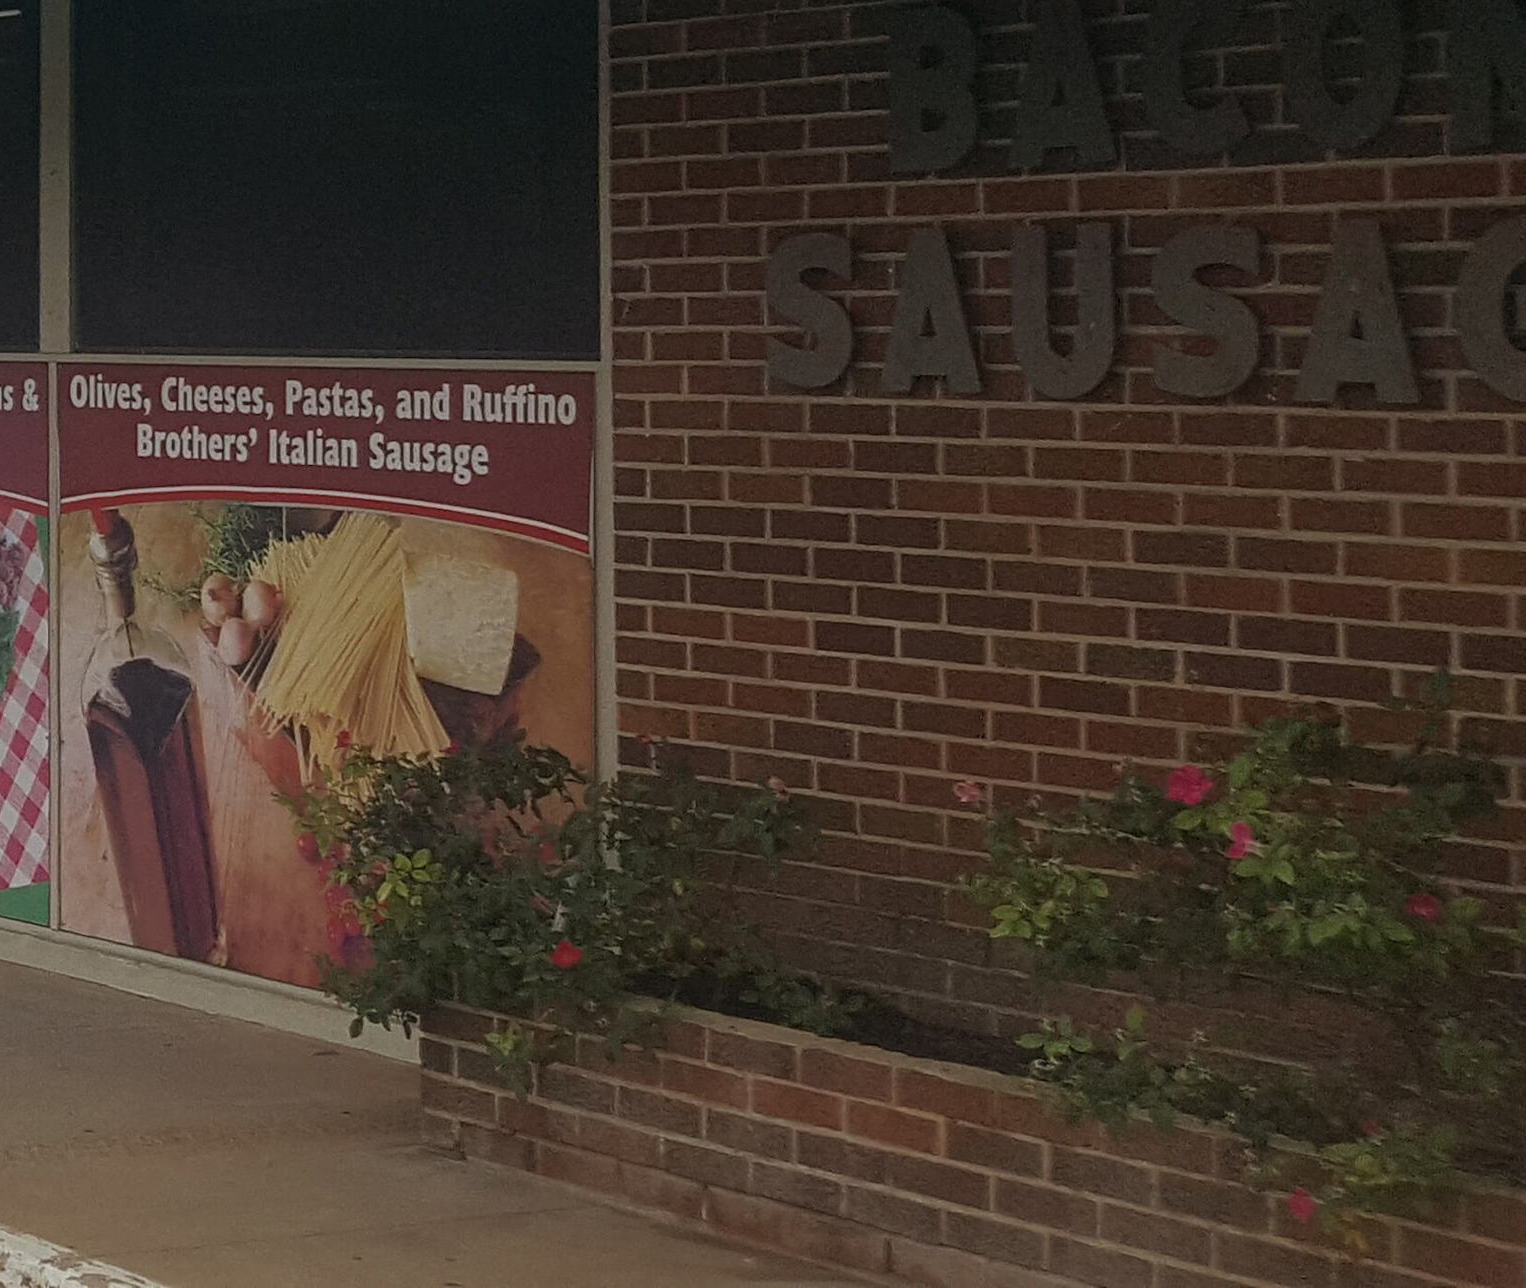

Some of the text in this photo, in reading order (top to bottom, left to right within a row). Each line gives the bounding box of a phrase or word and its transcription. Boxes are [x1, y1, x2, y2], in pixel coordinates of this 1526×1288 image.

[22, 379, 39, 411] &
[69, 374, 577, 426] Olives, Cheeses, Pastas, and Ruffino
[268, 428, 358, 468] Italian
[369, 432, 489, 485] Sausage
